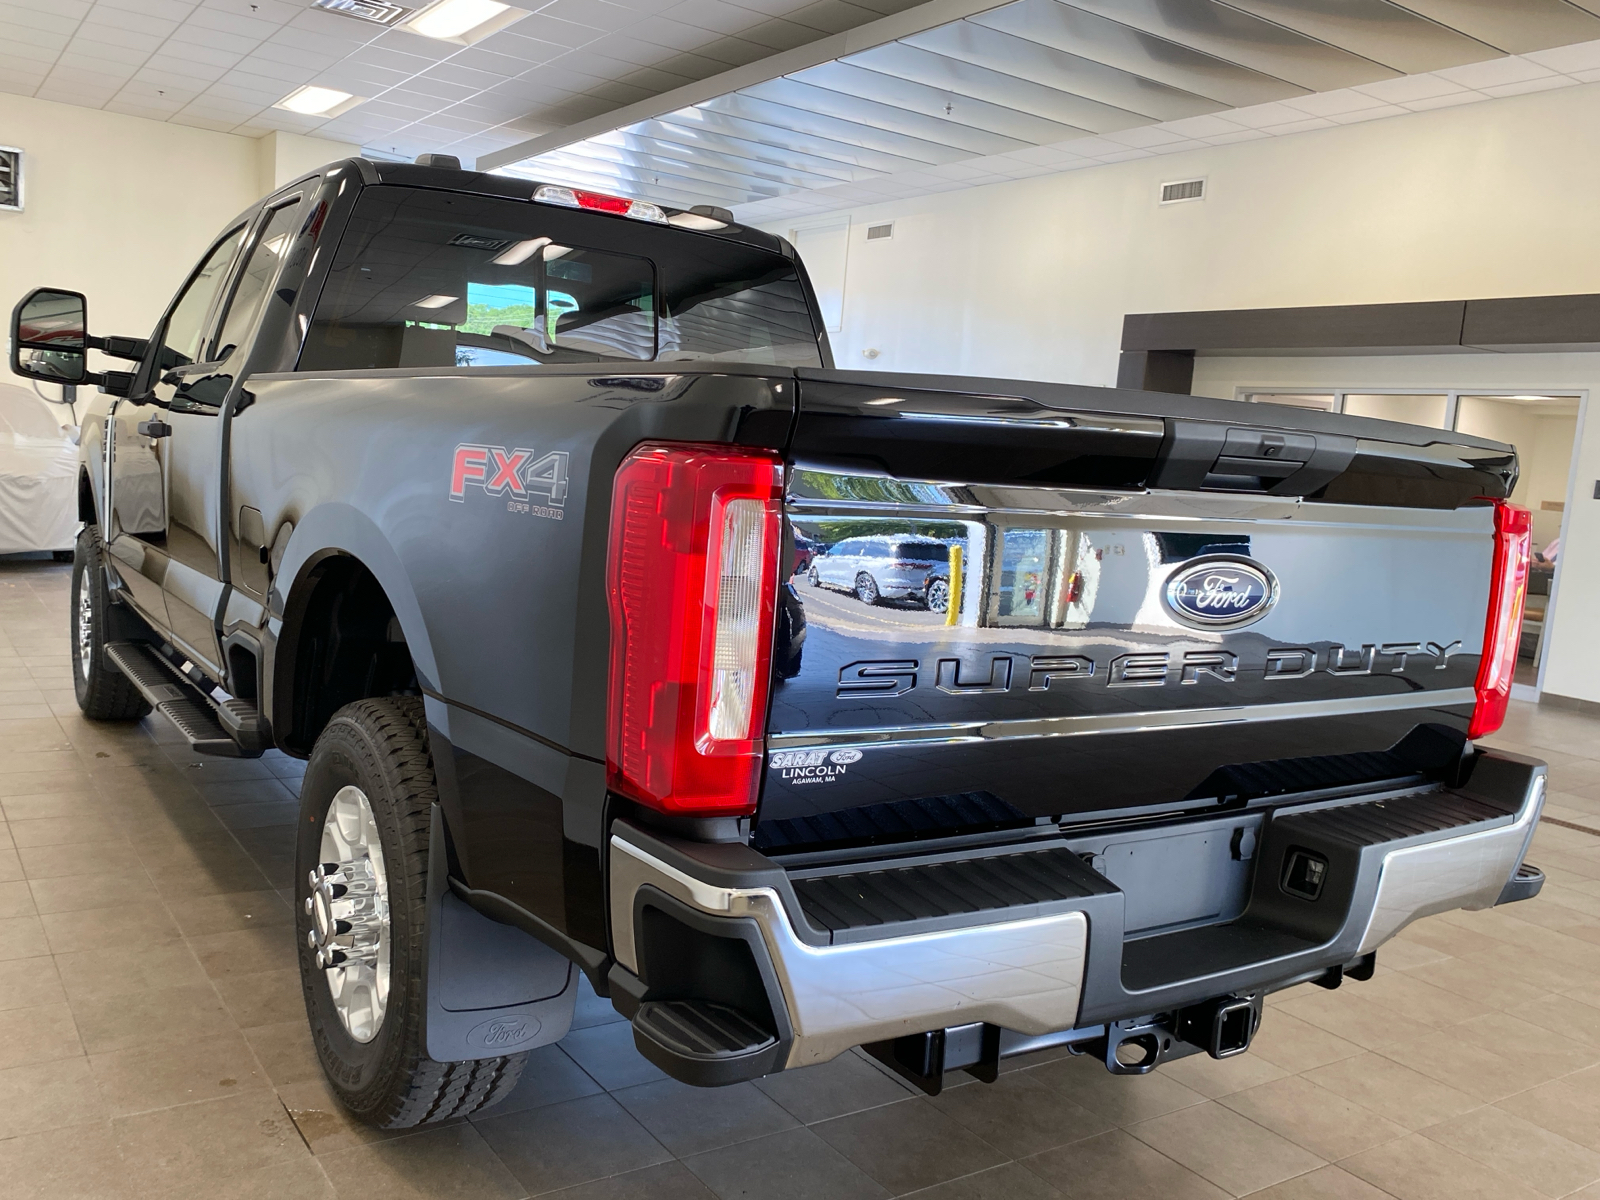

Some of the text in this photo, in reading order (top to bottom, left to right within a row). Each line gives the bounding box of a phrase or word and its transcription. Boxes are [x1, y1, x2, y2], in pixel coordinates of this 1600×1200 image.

[449, 442, 570, 507] FX4
[507, 501, 564, 520] OFF ROAD
[1195, 574, 1251, 609] Ford
[836, 639, 1463, 699] SUPER DUTY
[769, 750, 829, 769] SARAT
[782, 765, 847, 779] LINCOLN
[825, 775, 836, 783] MA
[484, 1019, 528, 1045] Ford
